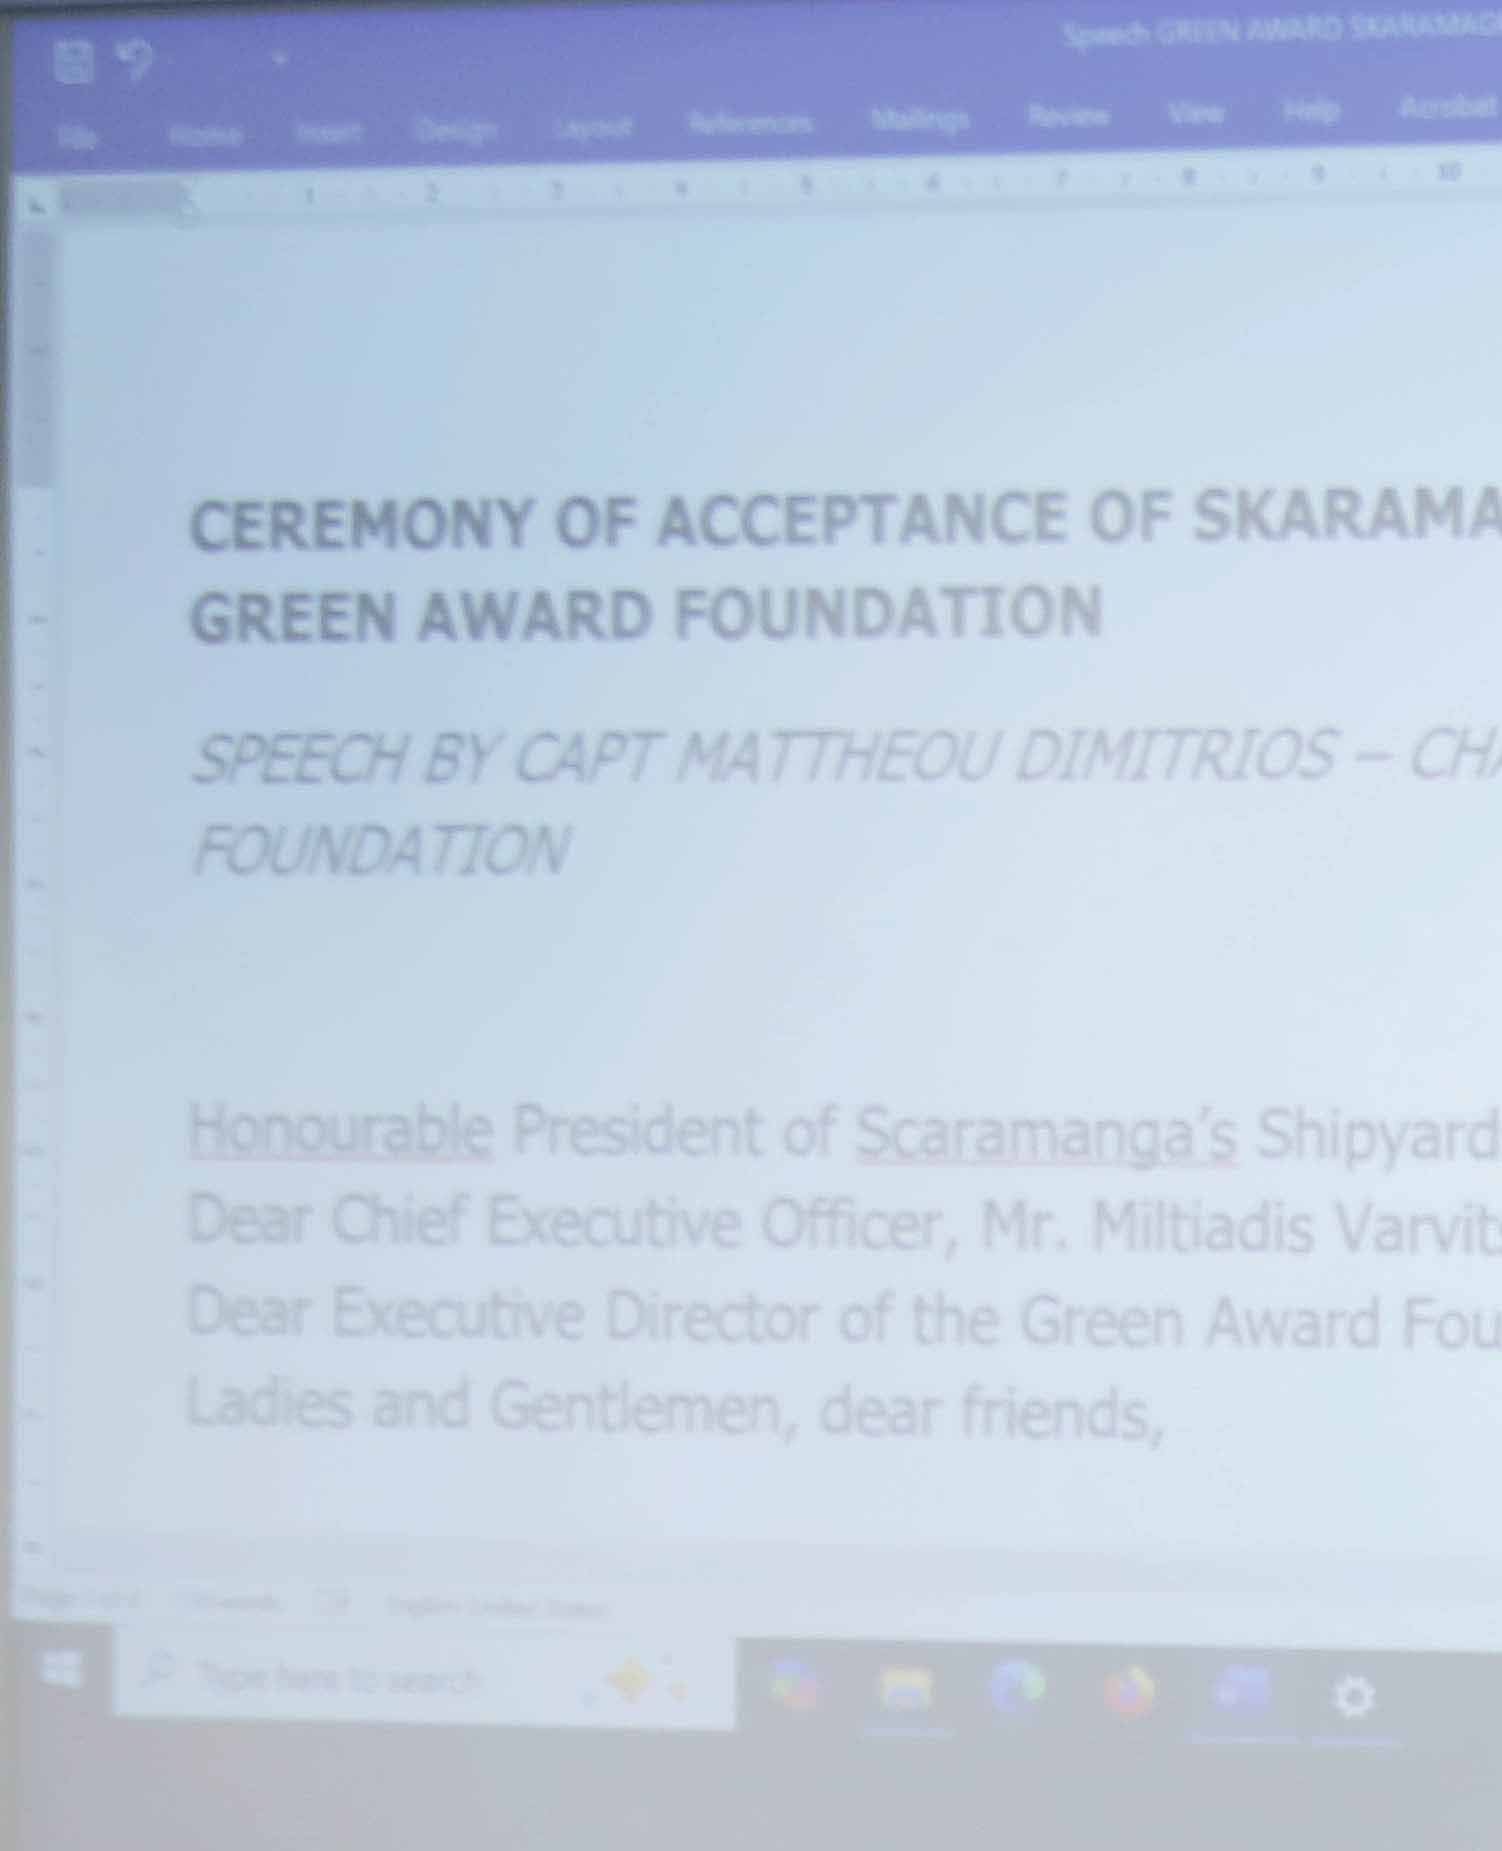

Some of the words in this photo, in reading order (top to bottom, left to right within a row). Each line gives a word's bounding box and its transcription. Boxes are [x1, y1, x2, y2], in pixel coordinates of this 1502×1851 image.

[1155, 18, 1239, 45] GREEN
[1248, 15, 1343, 43] AWARD
[413, 116, 498, 146] Design
[687, 109, 815, 135] References
[870, 107, 971, 135] Mailings
[1028, 101, 1111, 128] Review
[1168, 99, 1225, 126] View
[1283, 96, 1341, 126] Help
[1400, 93, 1497, 121] Acrobat
[189, 499, 534, 551] CEREMONY
[558, 496, 637, 547] OF
[657, 490, 1067, 546] ACCEPTANCE
[1090, 490, 1170, 543] OF
[190, 593, 397, 643] GREEN
[417, 588, 653, 641] AWARD
[677, 583, 1103, 639] FOUNDATION
[191, 732, 410, 787] SPEECH
[424, 732, 500, 784] BY
[516, 730, 665, 784] CAPT
[676, 728, 1000, 783] MATTHEOU
[1015, 726, 1340, 782] DIMITRIOS
[191, 824, 572, 878] FOUNDATION
[186, 1101, 494, 1157] Honourable
[514, 1103, 763, 1158] President
[783, 1103, 838, 1157] of
[187, 1193, 311, 1245] Dear
[332, 1193, 470, 1247] Chief
[488, 1195, 742, 1249] Executive
[761, 1196, 958, 1261] Officer,
[982, 1199, 1068, 1252] Mr.
[1093, 1197, 1314, 1254] Miltiadis
[187, 1285, 311, 1337] Dear
[333, 1287, 585, 1341] Executive
[606, 1288, 818, 1343] Director
[838, 1289, 894, 1344] of
[913, 1291, 1001, 1345] the
[1020, 1293, 1183, 1348] Green
[1206, 1295, 1381, 1350] Award
[186, 1376, 353, 1430] Ladies
[372, 1378, 470, 1430] and
[492, 1378, 798, 1444] Gentlemen,
[819, 1385, 939, 1439] dear
[960, 1386, 1166, 1450] friends,
[196, 1659, 269, 1697] Type
[274, 1660, 337, 1692] here
[347, 1665, 376, 1694] to
[388, 1665, 482, 1695] search
